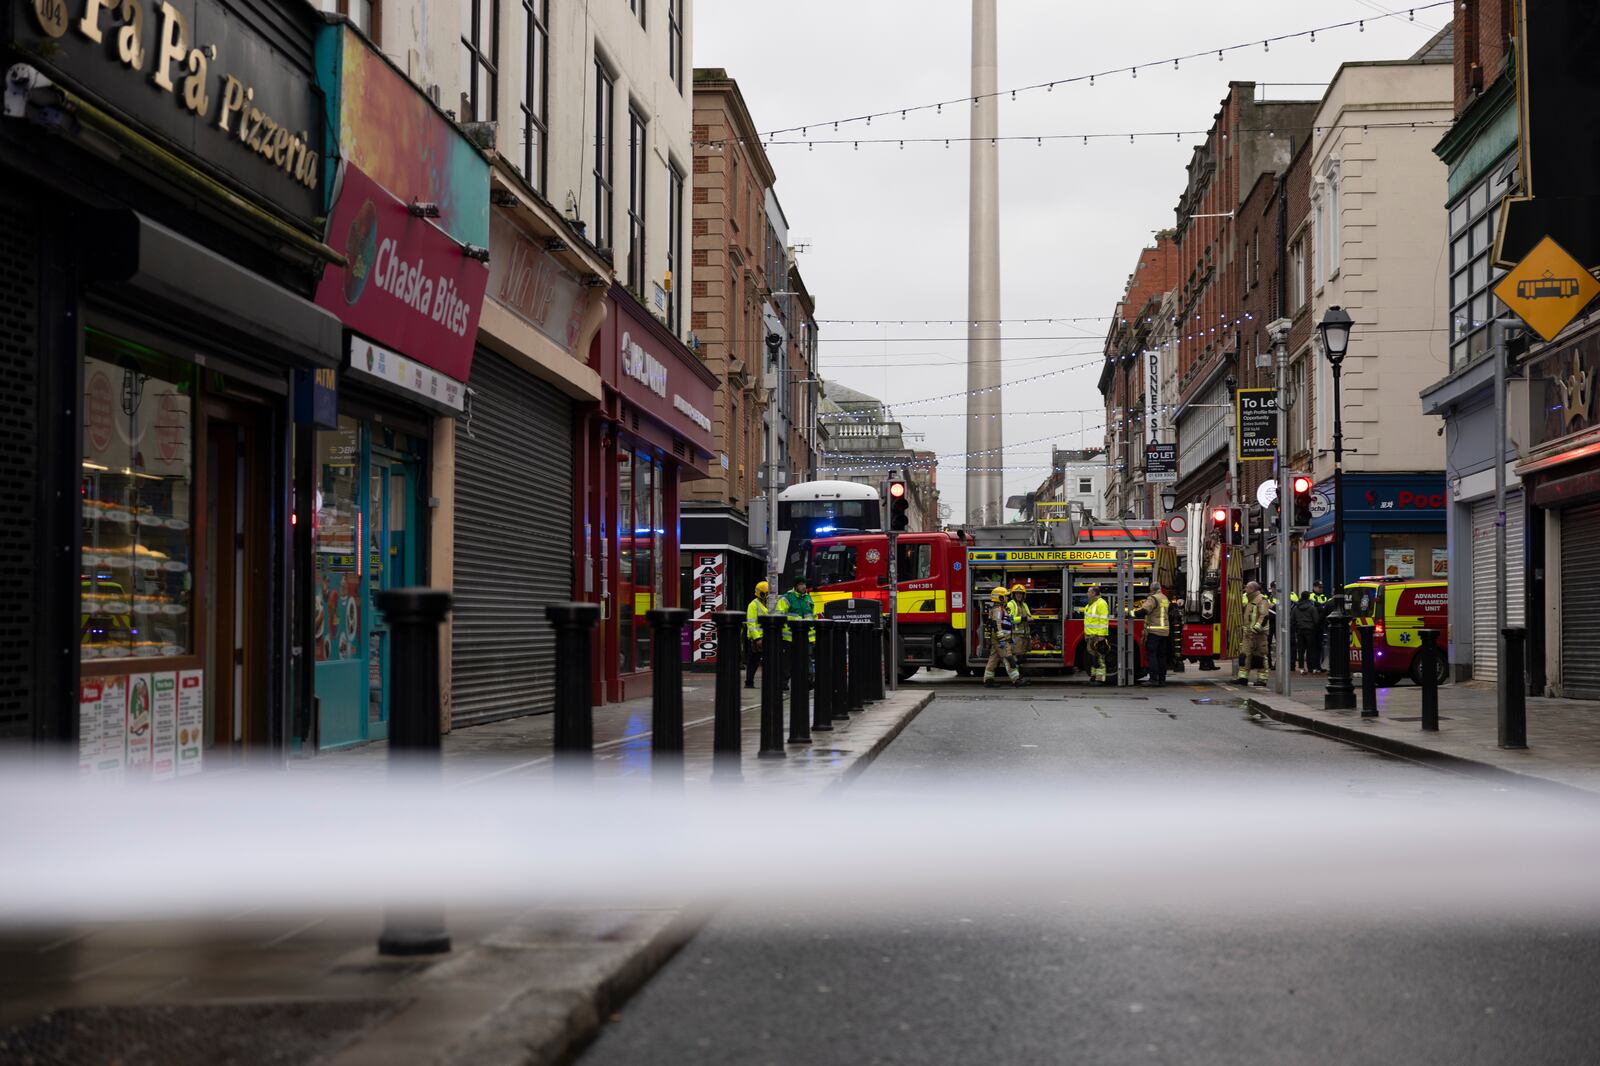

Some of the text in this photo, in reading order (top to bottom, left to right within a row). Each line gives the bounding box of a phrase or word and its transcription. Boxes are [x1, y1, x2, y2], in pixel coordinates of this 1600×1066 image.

[218, 74, 320, 191] Pizzeria
[374, 237, 470, 337] Chaska Bites
[315, 367, 337, 391] ATM
[1149, 354, 1158, 415] DUNNES
[1241, 397, 1258, 408] To
[1243, 438, 1271, 447] HWBC
[1159, 451, 1175, 459] LET
[1398, 490, 1447, 510] Poc
[1011, 551, 1111, 560] DUBLIN FIRE BRIGADE
[700, 556, 718, 613] BARBER
[699, 621, 718, 661] SHOP
[1349, 649, 1362, 661] IR
